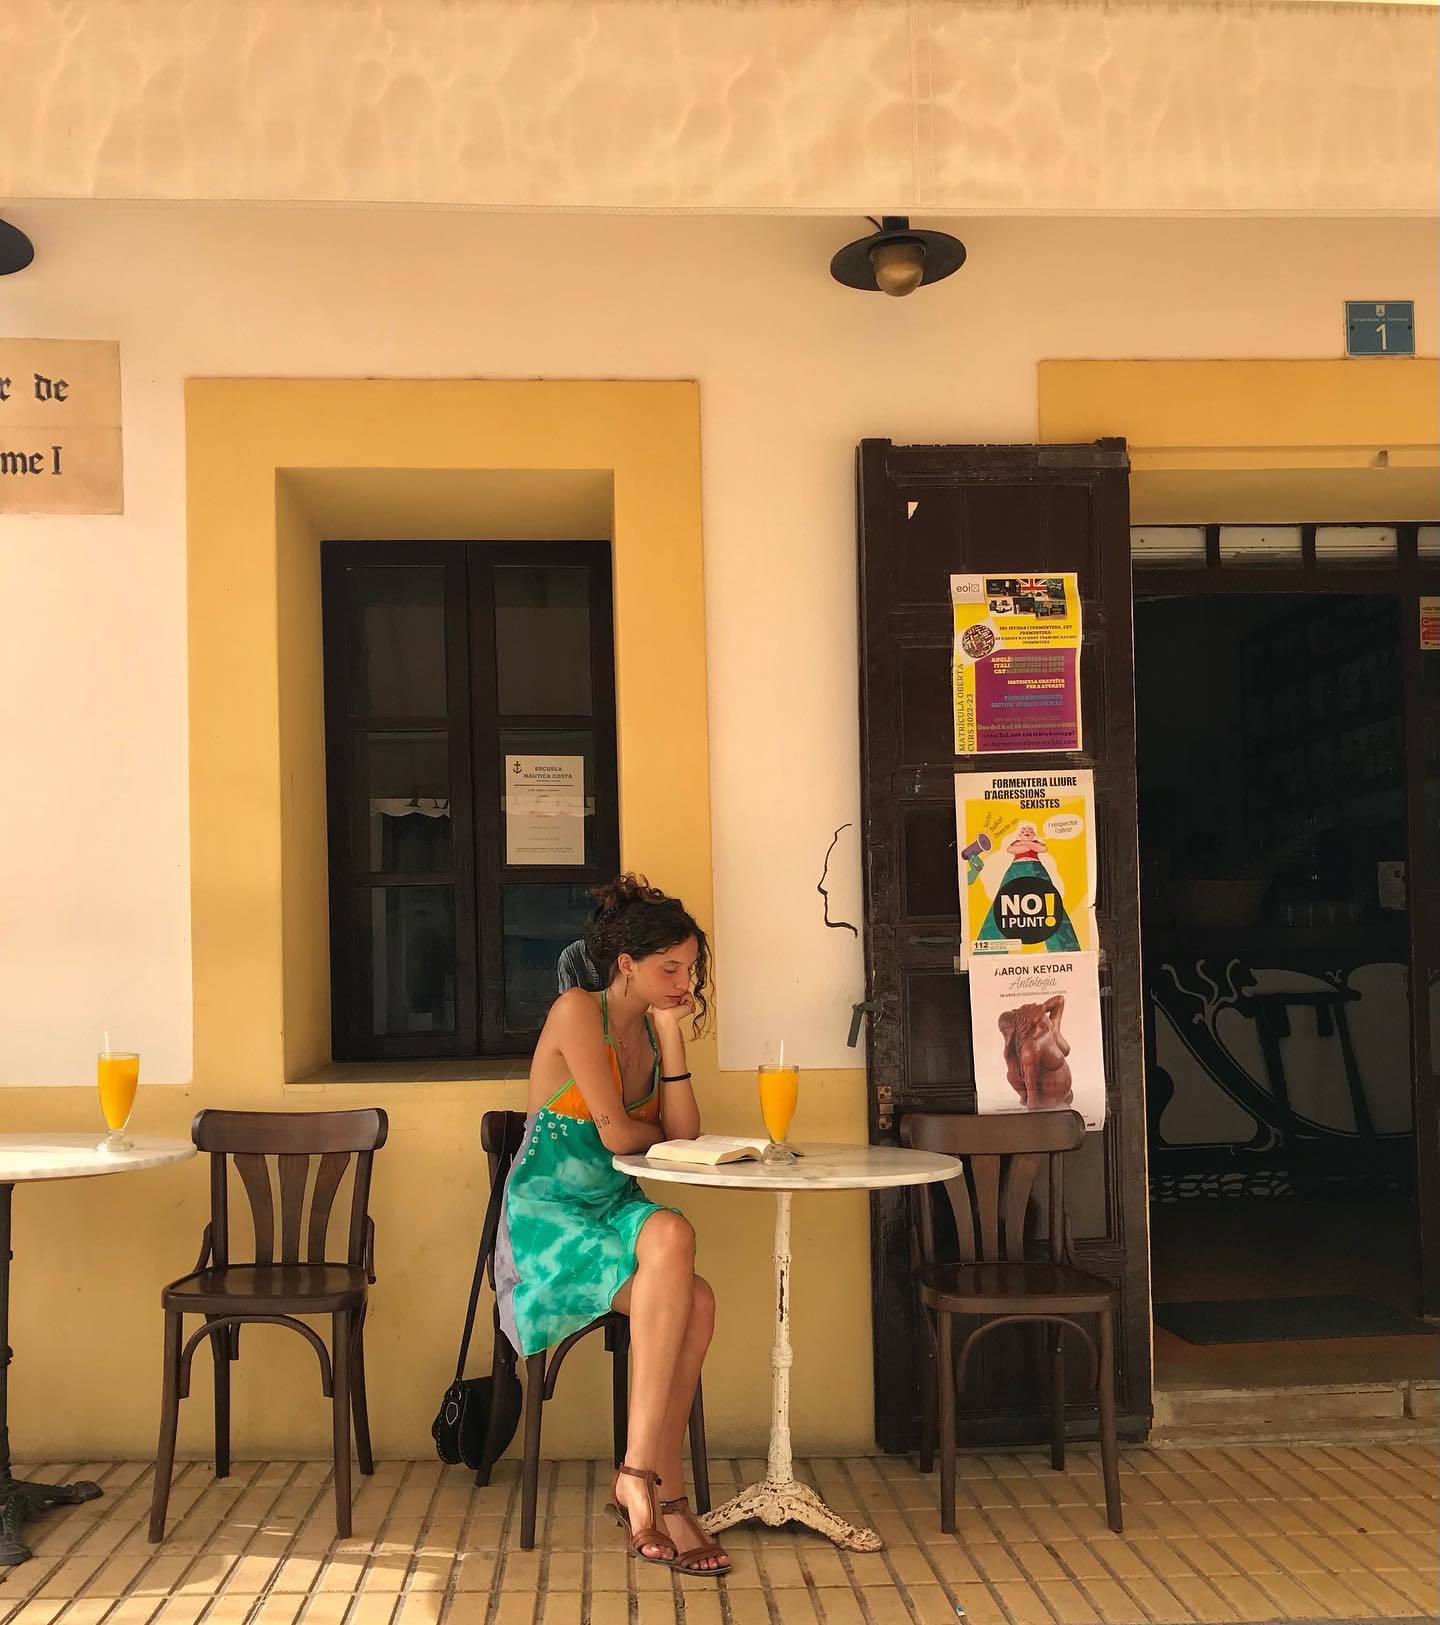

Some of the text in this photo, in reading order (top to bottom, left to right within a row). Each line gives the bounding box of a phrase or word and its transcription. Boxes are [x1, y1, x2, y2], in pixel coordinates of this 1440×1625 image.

[1376, 323, 1387, 350] 1
[34, 373, 70, 403] de
[956, 582, 971, 593] eoi
[956, 663, 964, 698] OBERTA
[966, 693, 974, 726] 2022-23
[992, 776, 1077, 789] FORMENTERA LLIURE
[984, 789, 1045, 800] D'AGRESSIONS
[1020, 799, 1060, 810] SEXISTES
[1009, 916, 1045, 928] PUNT
[974, 941, 989, 949] 112
[1033, 963, 1073, 974] KEYDAR
